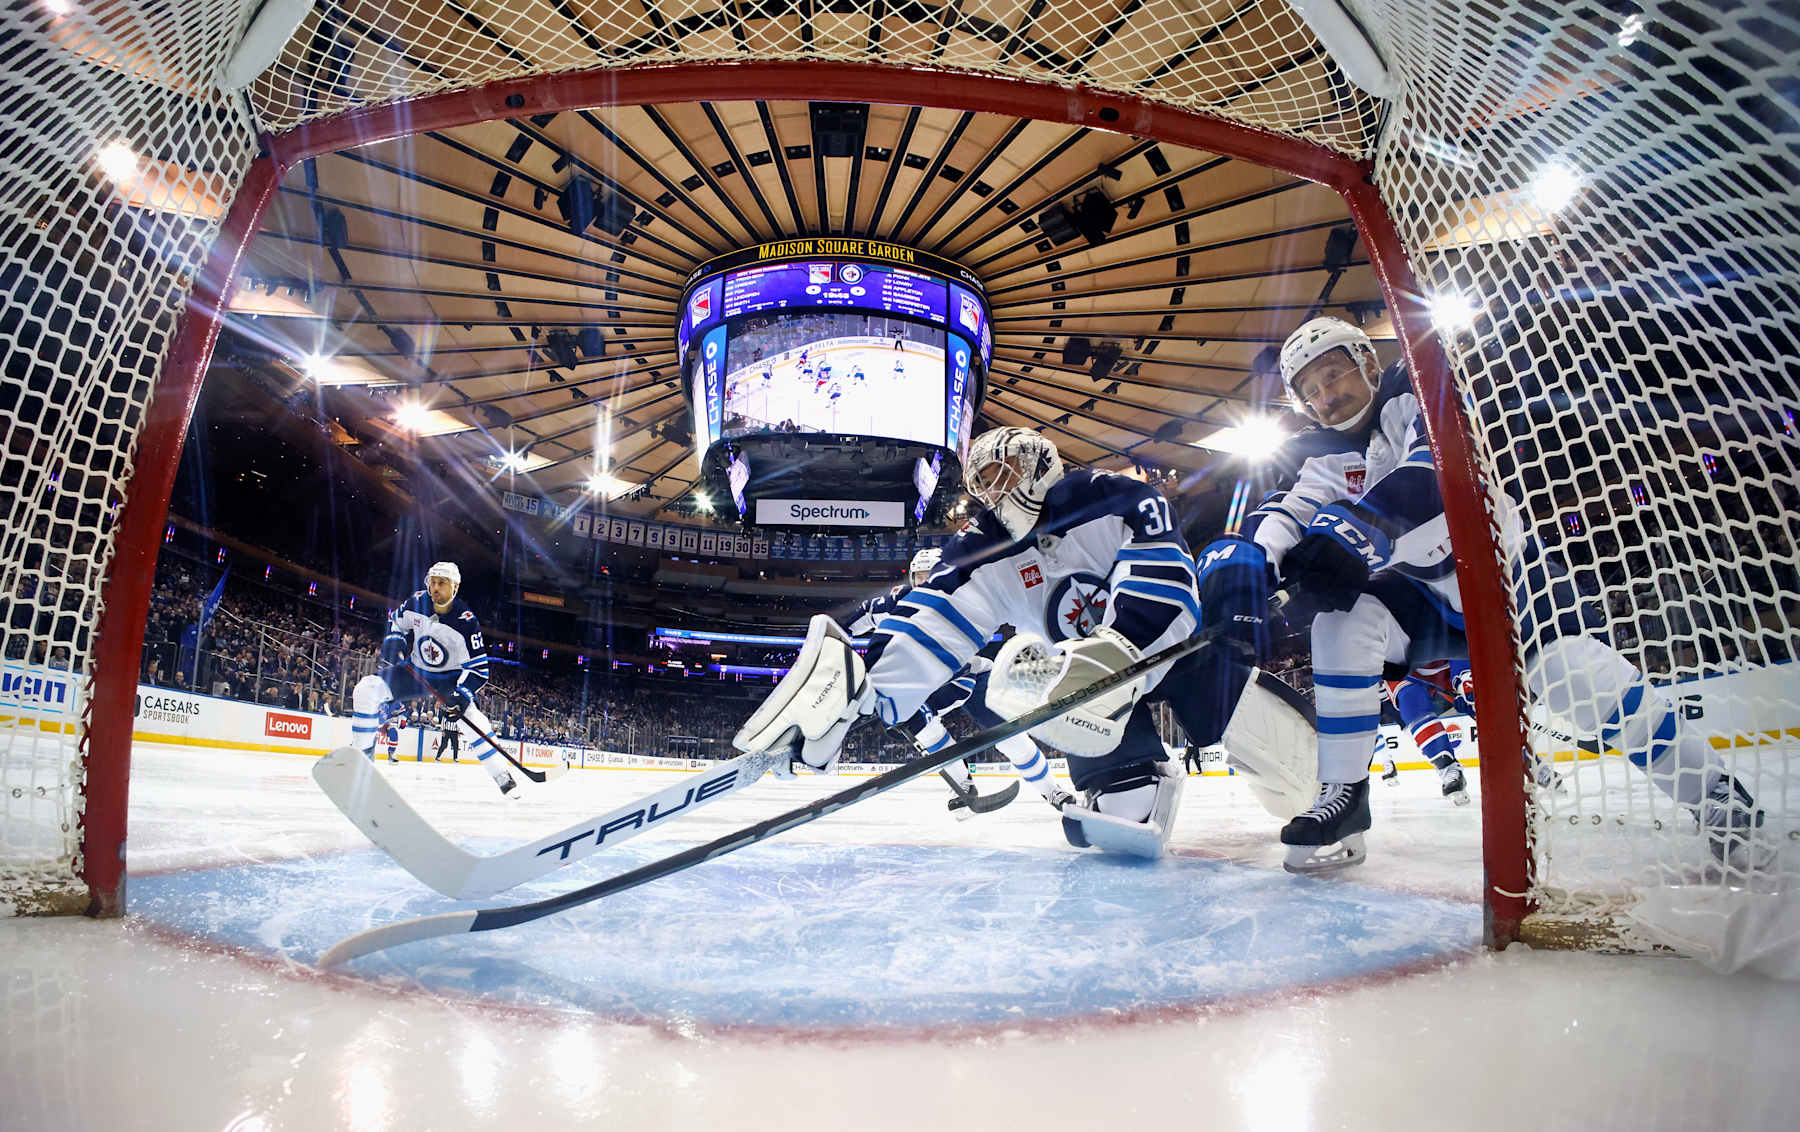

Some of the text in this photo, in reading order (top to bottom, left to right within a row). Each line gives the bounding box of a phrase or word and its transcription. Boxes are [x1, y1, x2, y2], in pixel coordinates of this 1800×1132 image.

[817, 239, 865, 254] SQUARE
[868, 241, 915, 263] GARDEN
[707, 360, 719, 425] CHASE
[950, 367, 965, 433] CHASE
[790, 504, 865, 522] Spectrum
[1138, 495, 1173, 536] 37
[684, 536, 694, 548] 11
[703, 539, 713, 550] 11
[720, 540, 732, 551] 19
[735, 542, 749, 553] 30
[753, 543, 767, 553] 35
[1311, 513, 1384, 567] CCM
[144, 696, 200, 715] CAESARS
[143, 709, 190, 724] SPORTSBOOK
[269, 717, 309, 735] Lenovo
[536, 769, 740, 860] TRUE
